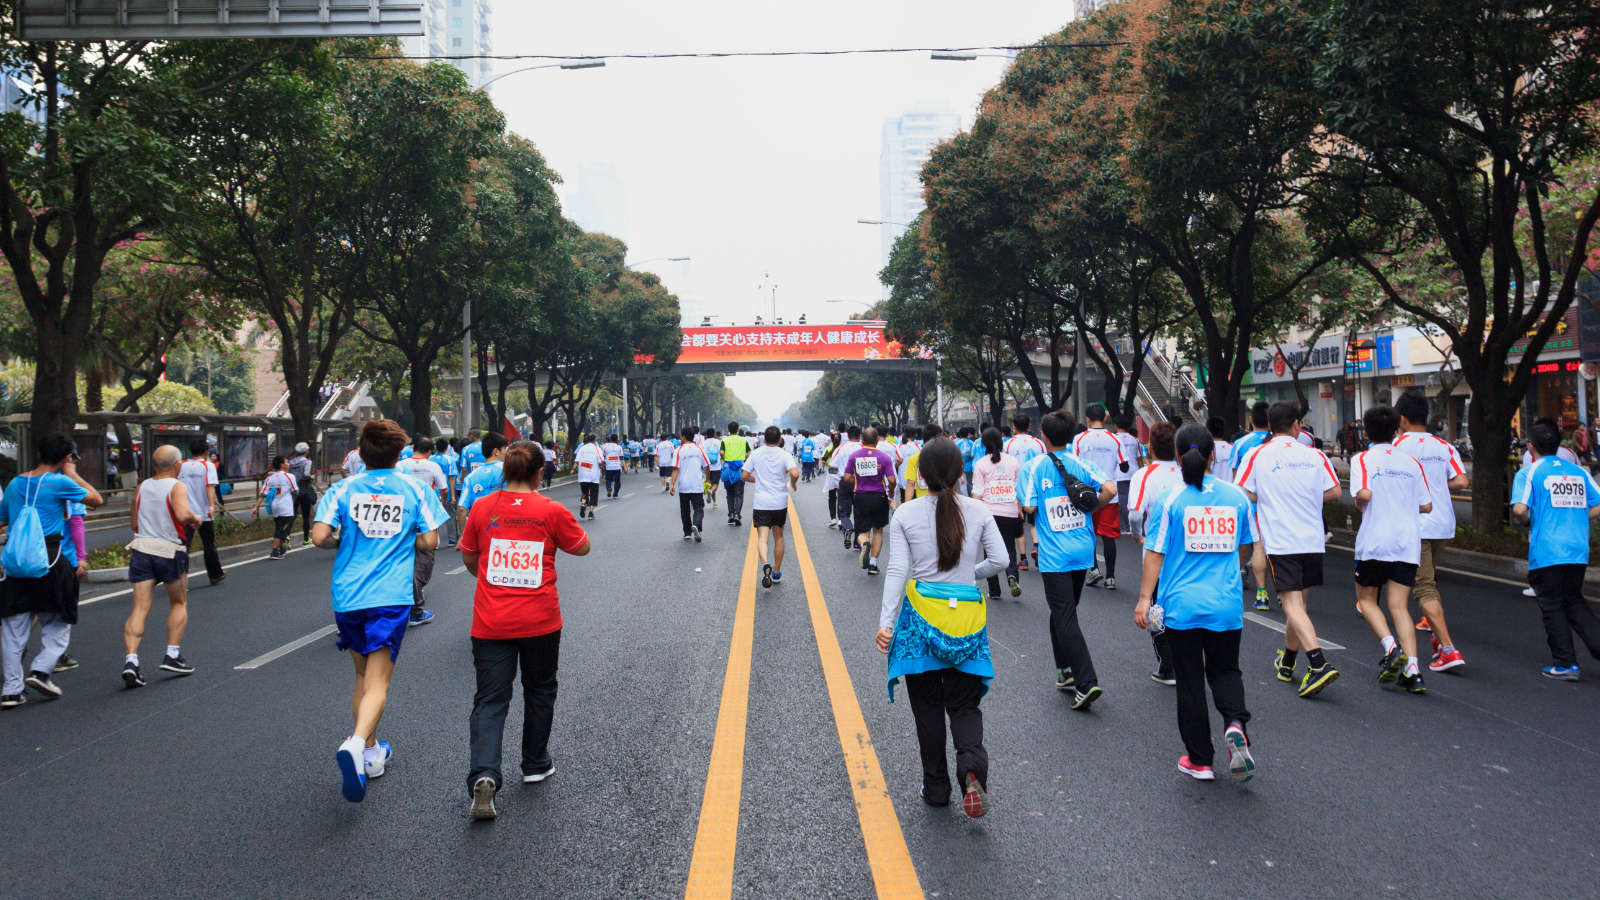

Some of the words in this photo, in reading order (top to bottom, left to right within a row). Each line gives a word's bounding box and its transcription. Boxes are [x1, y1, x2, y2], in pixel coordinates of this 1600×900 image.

[990, 485, 1013, 495] 02640
[1552, 483, 1584, 495] 20978
[353, 503, 401, 523] 17762
[1050, 504, 1081, 519] 1015
[1188, 517, 1235, 535] 01183
[491, 550, 540, 571] 01634
